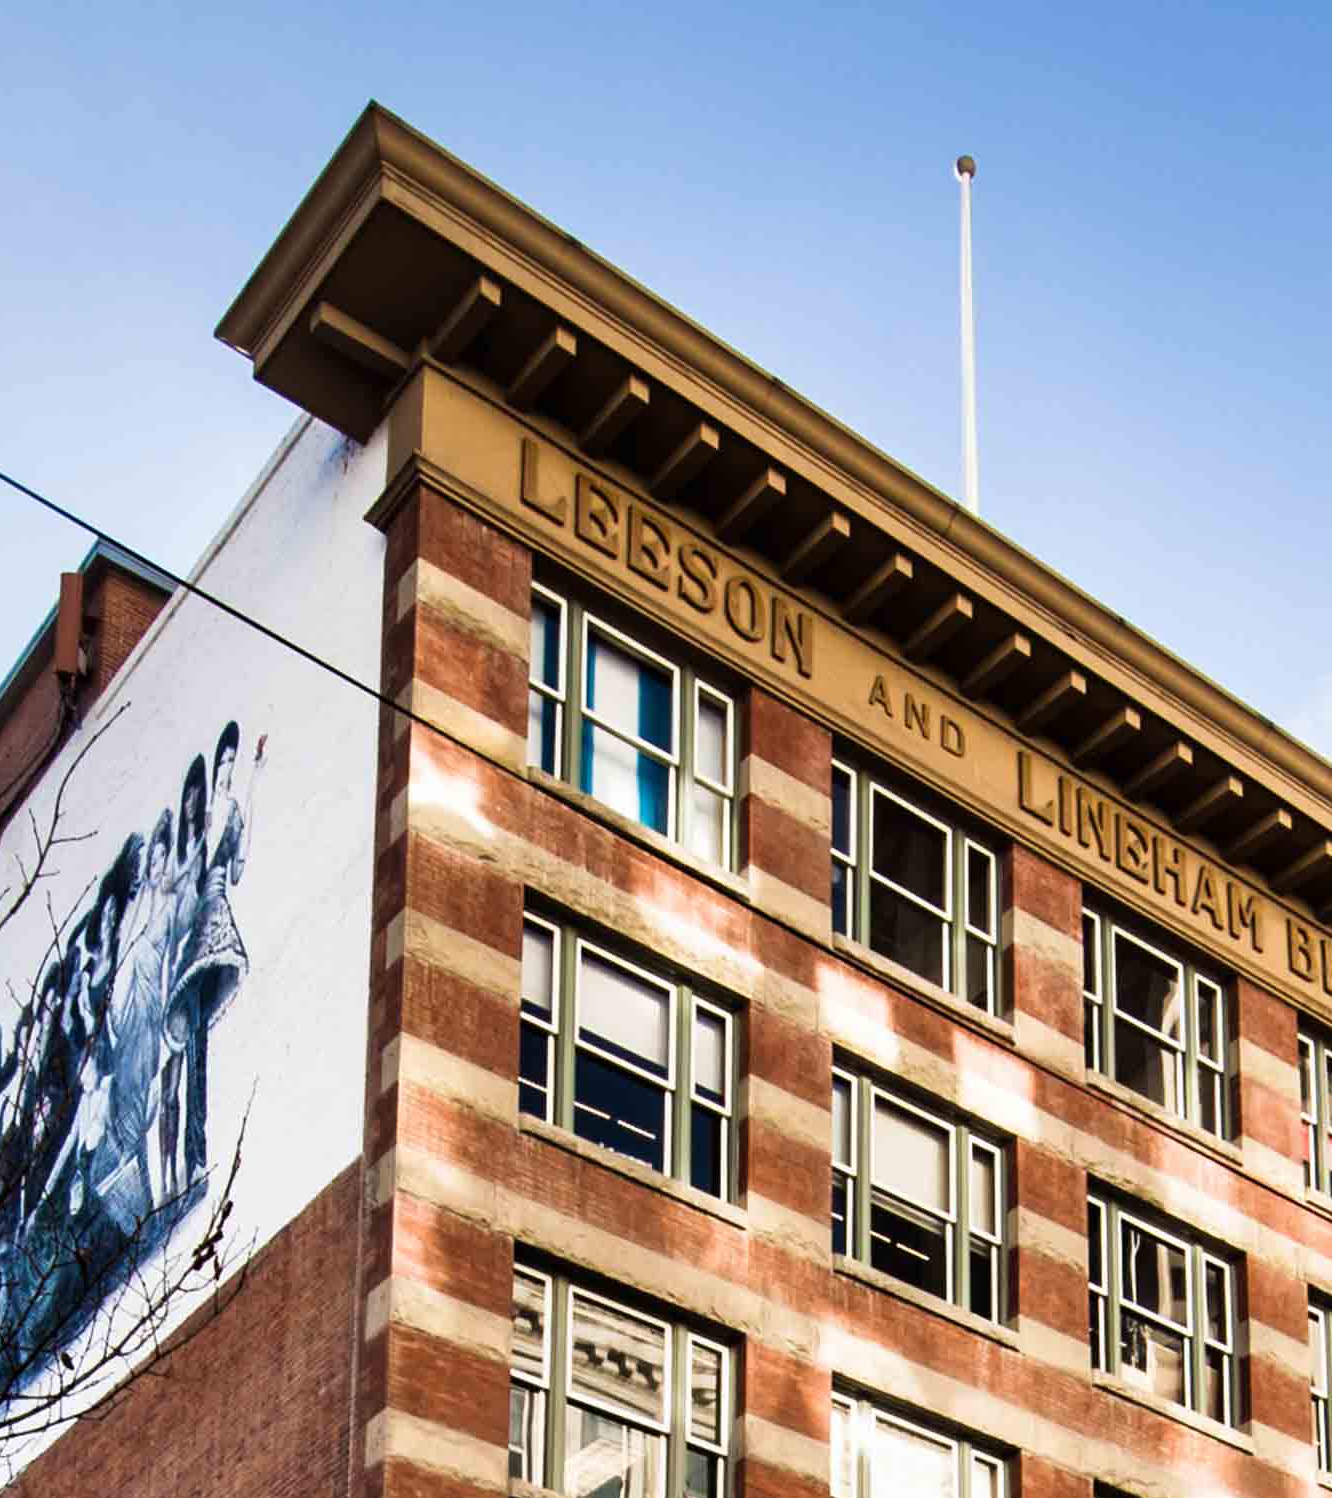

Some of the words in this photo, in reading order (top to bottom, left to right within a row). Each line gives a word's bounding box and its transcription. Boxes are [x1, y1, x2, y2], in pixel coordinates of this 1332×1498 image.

[519, 435, 815, 681] LEESON
[868, 673, 965, 757] AND
[1017, 750, 1264, 955] LINEHAM
